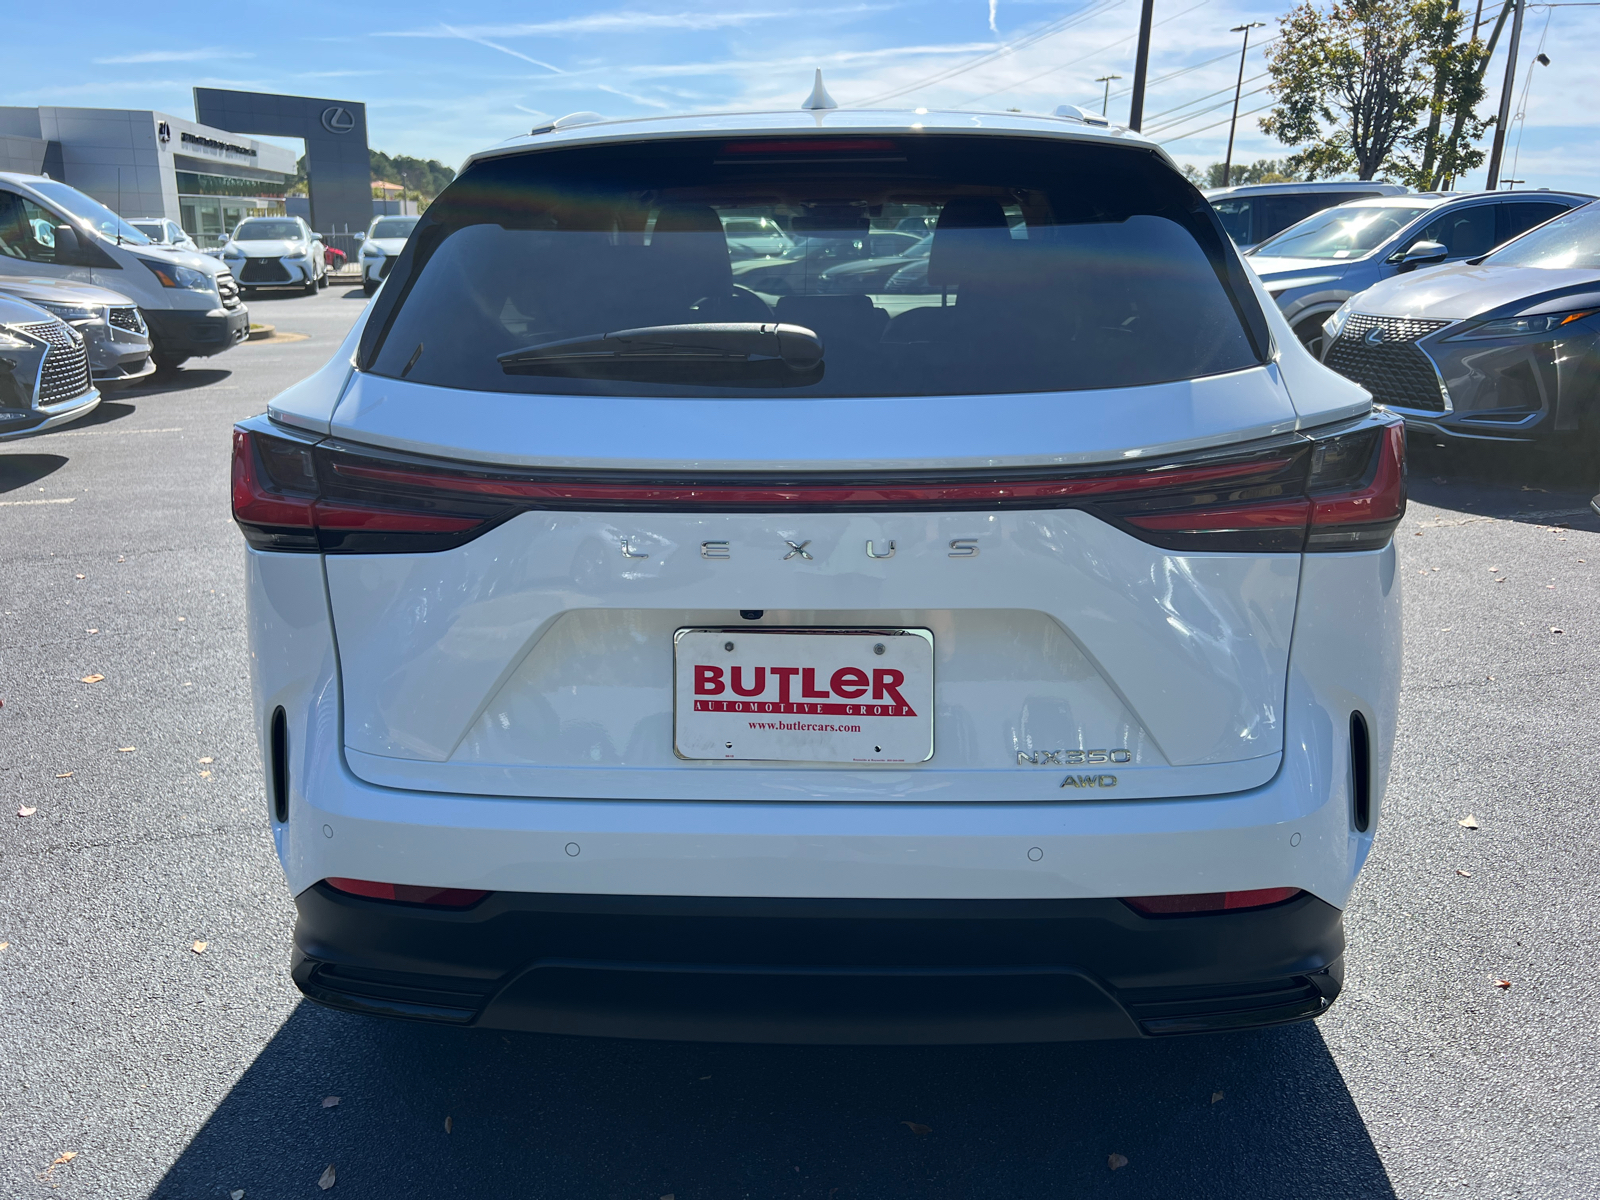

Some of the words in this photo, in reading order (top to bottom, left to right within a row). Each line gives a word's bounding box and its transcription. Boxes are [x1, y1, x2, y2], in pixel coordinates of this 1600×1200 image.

[620, 538, 982, 561] LEXUS
[695, 701, 824, 714] AUTOMOTIVE
[846, 704, 909, 716] GROUP
[748, 720, 862, 733] www.butlercars.com
[1016, 748, 1132, 766] NX350
[1059, 774, 1118, 788] AWD
